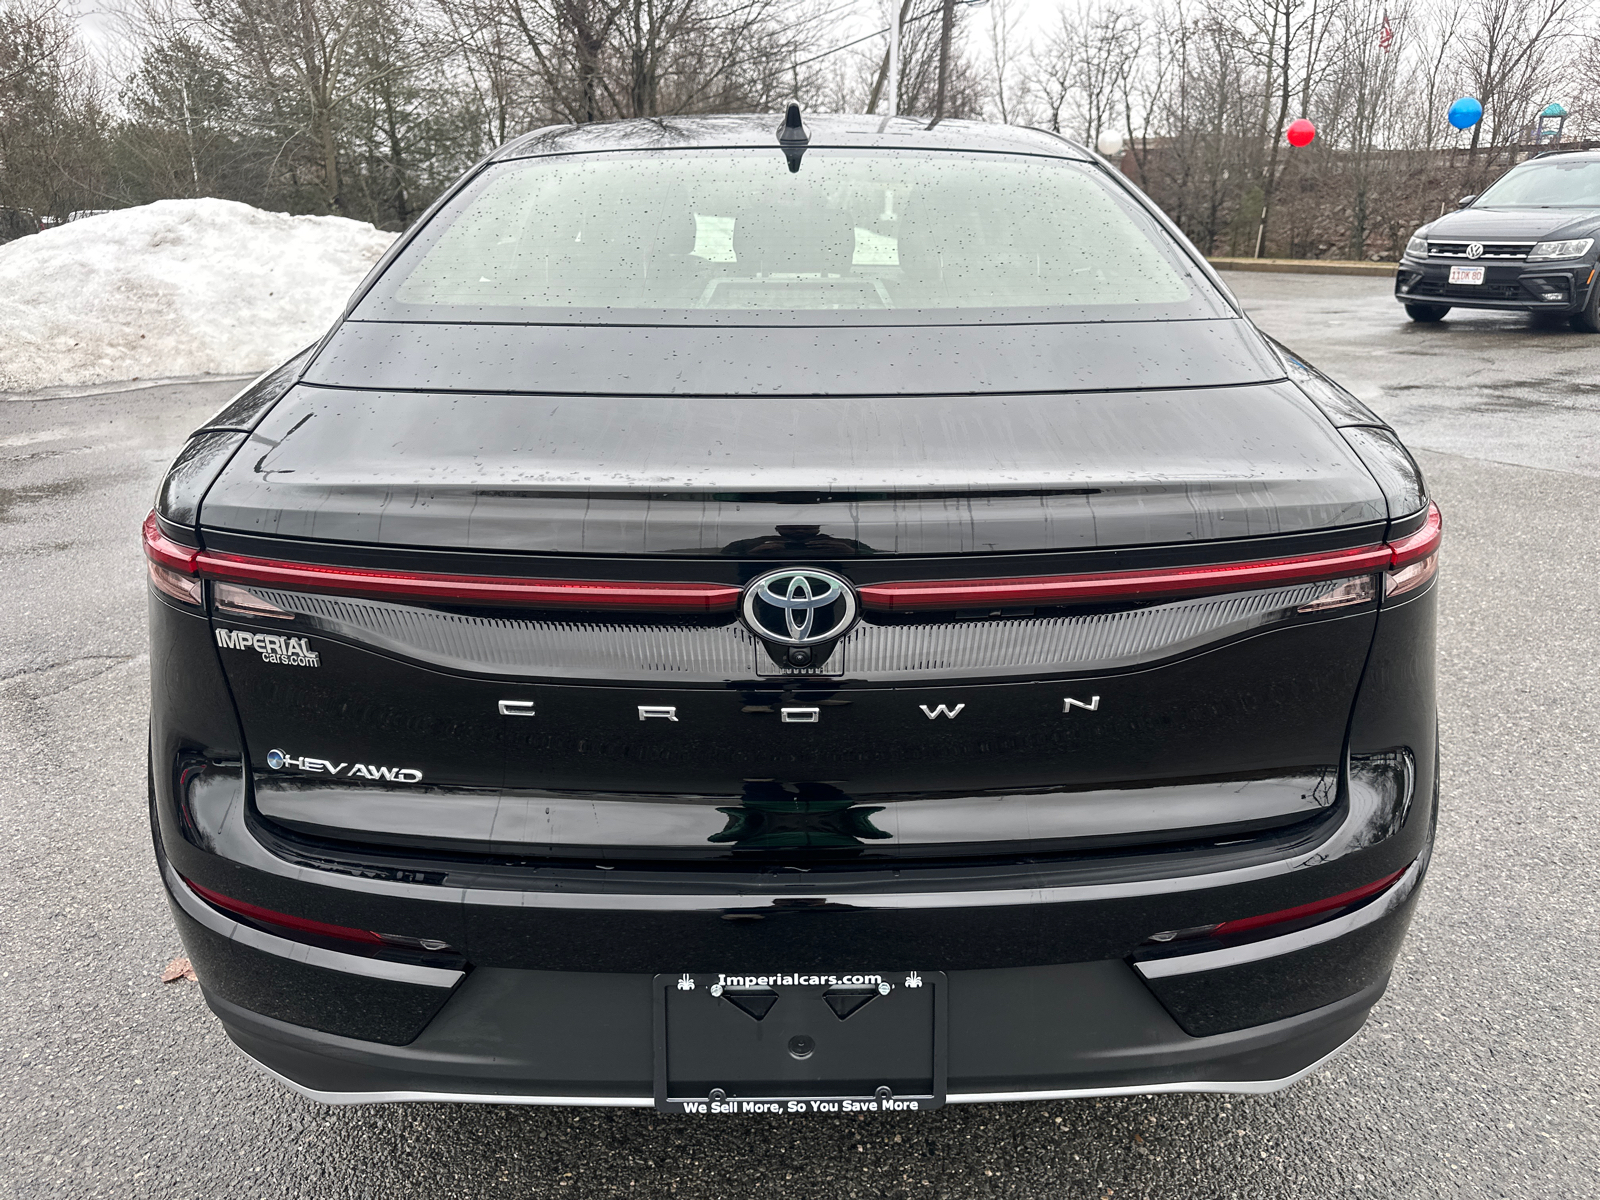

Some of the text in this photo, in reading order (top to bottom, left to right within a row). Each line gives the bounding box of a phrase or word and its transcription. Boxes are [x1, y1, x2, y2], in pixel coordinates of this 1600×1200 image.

[215, 628, 319, 658] IMPERIAL
[262, 651, 321, 667] cars.com
[498, 695, 1100, 723] CROWN
[283, 754, 423, 783] HEV AWD
[718, 973, 882, 987] Imperialcars.com
[683, 1099, 919, 1114] We Sell More, So You Save More
